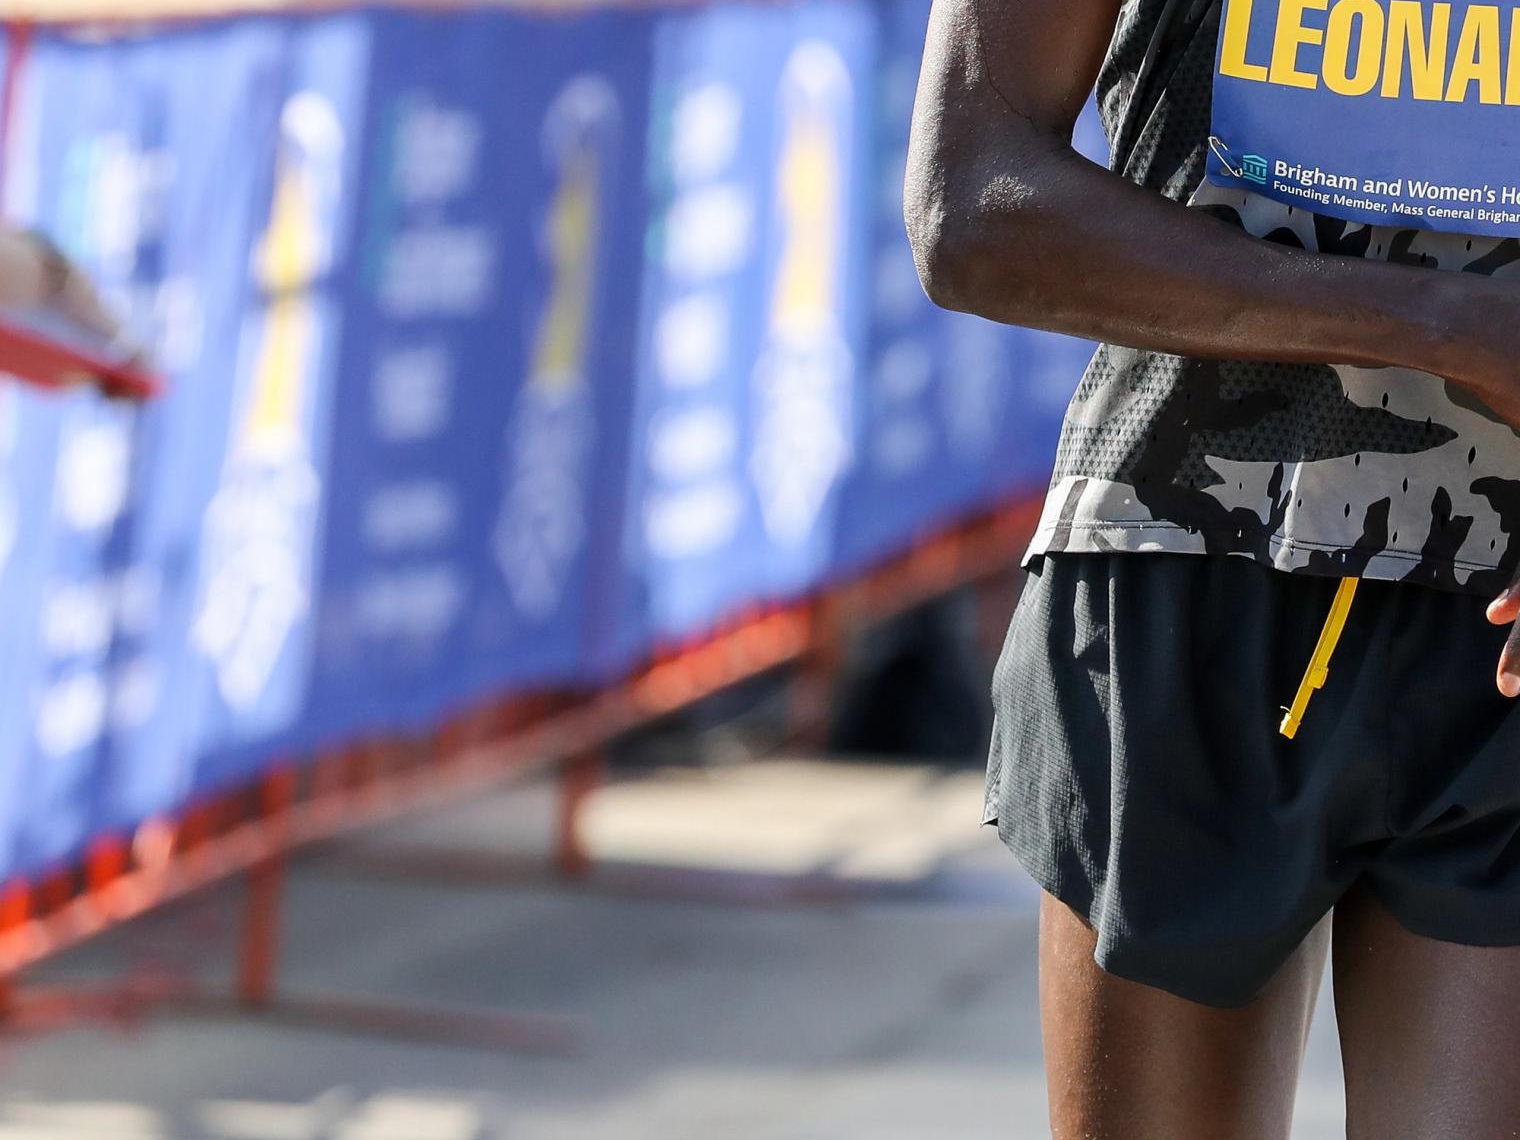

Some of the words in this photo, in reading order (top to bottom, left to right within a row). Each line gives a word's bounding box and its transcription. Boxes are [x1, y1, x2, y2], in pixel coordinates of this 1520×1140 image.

[1273, 180, 1330, 204] Founding
[1333, 194, 1388, 214] Member,
[1392, 202, 1424, 216] Mass
[1427, 205, 1474, 221] General
[1274, 160, 1357, 186] Brigham
[1363, 179, 1402, 197] and
[1408, 180, 1496, 204] Women's
